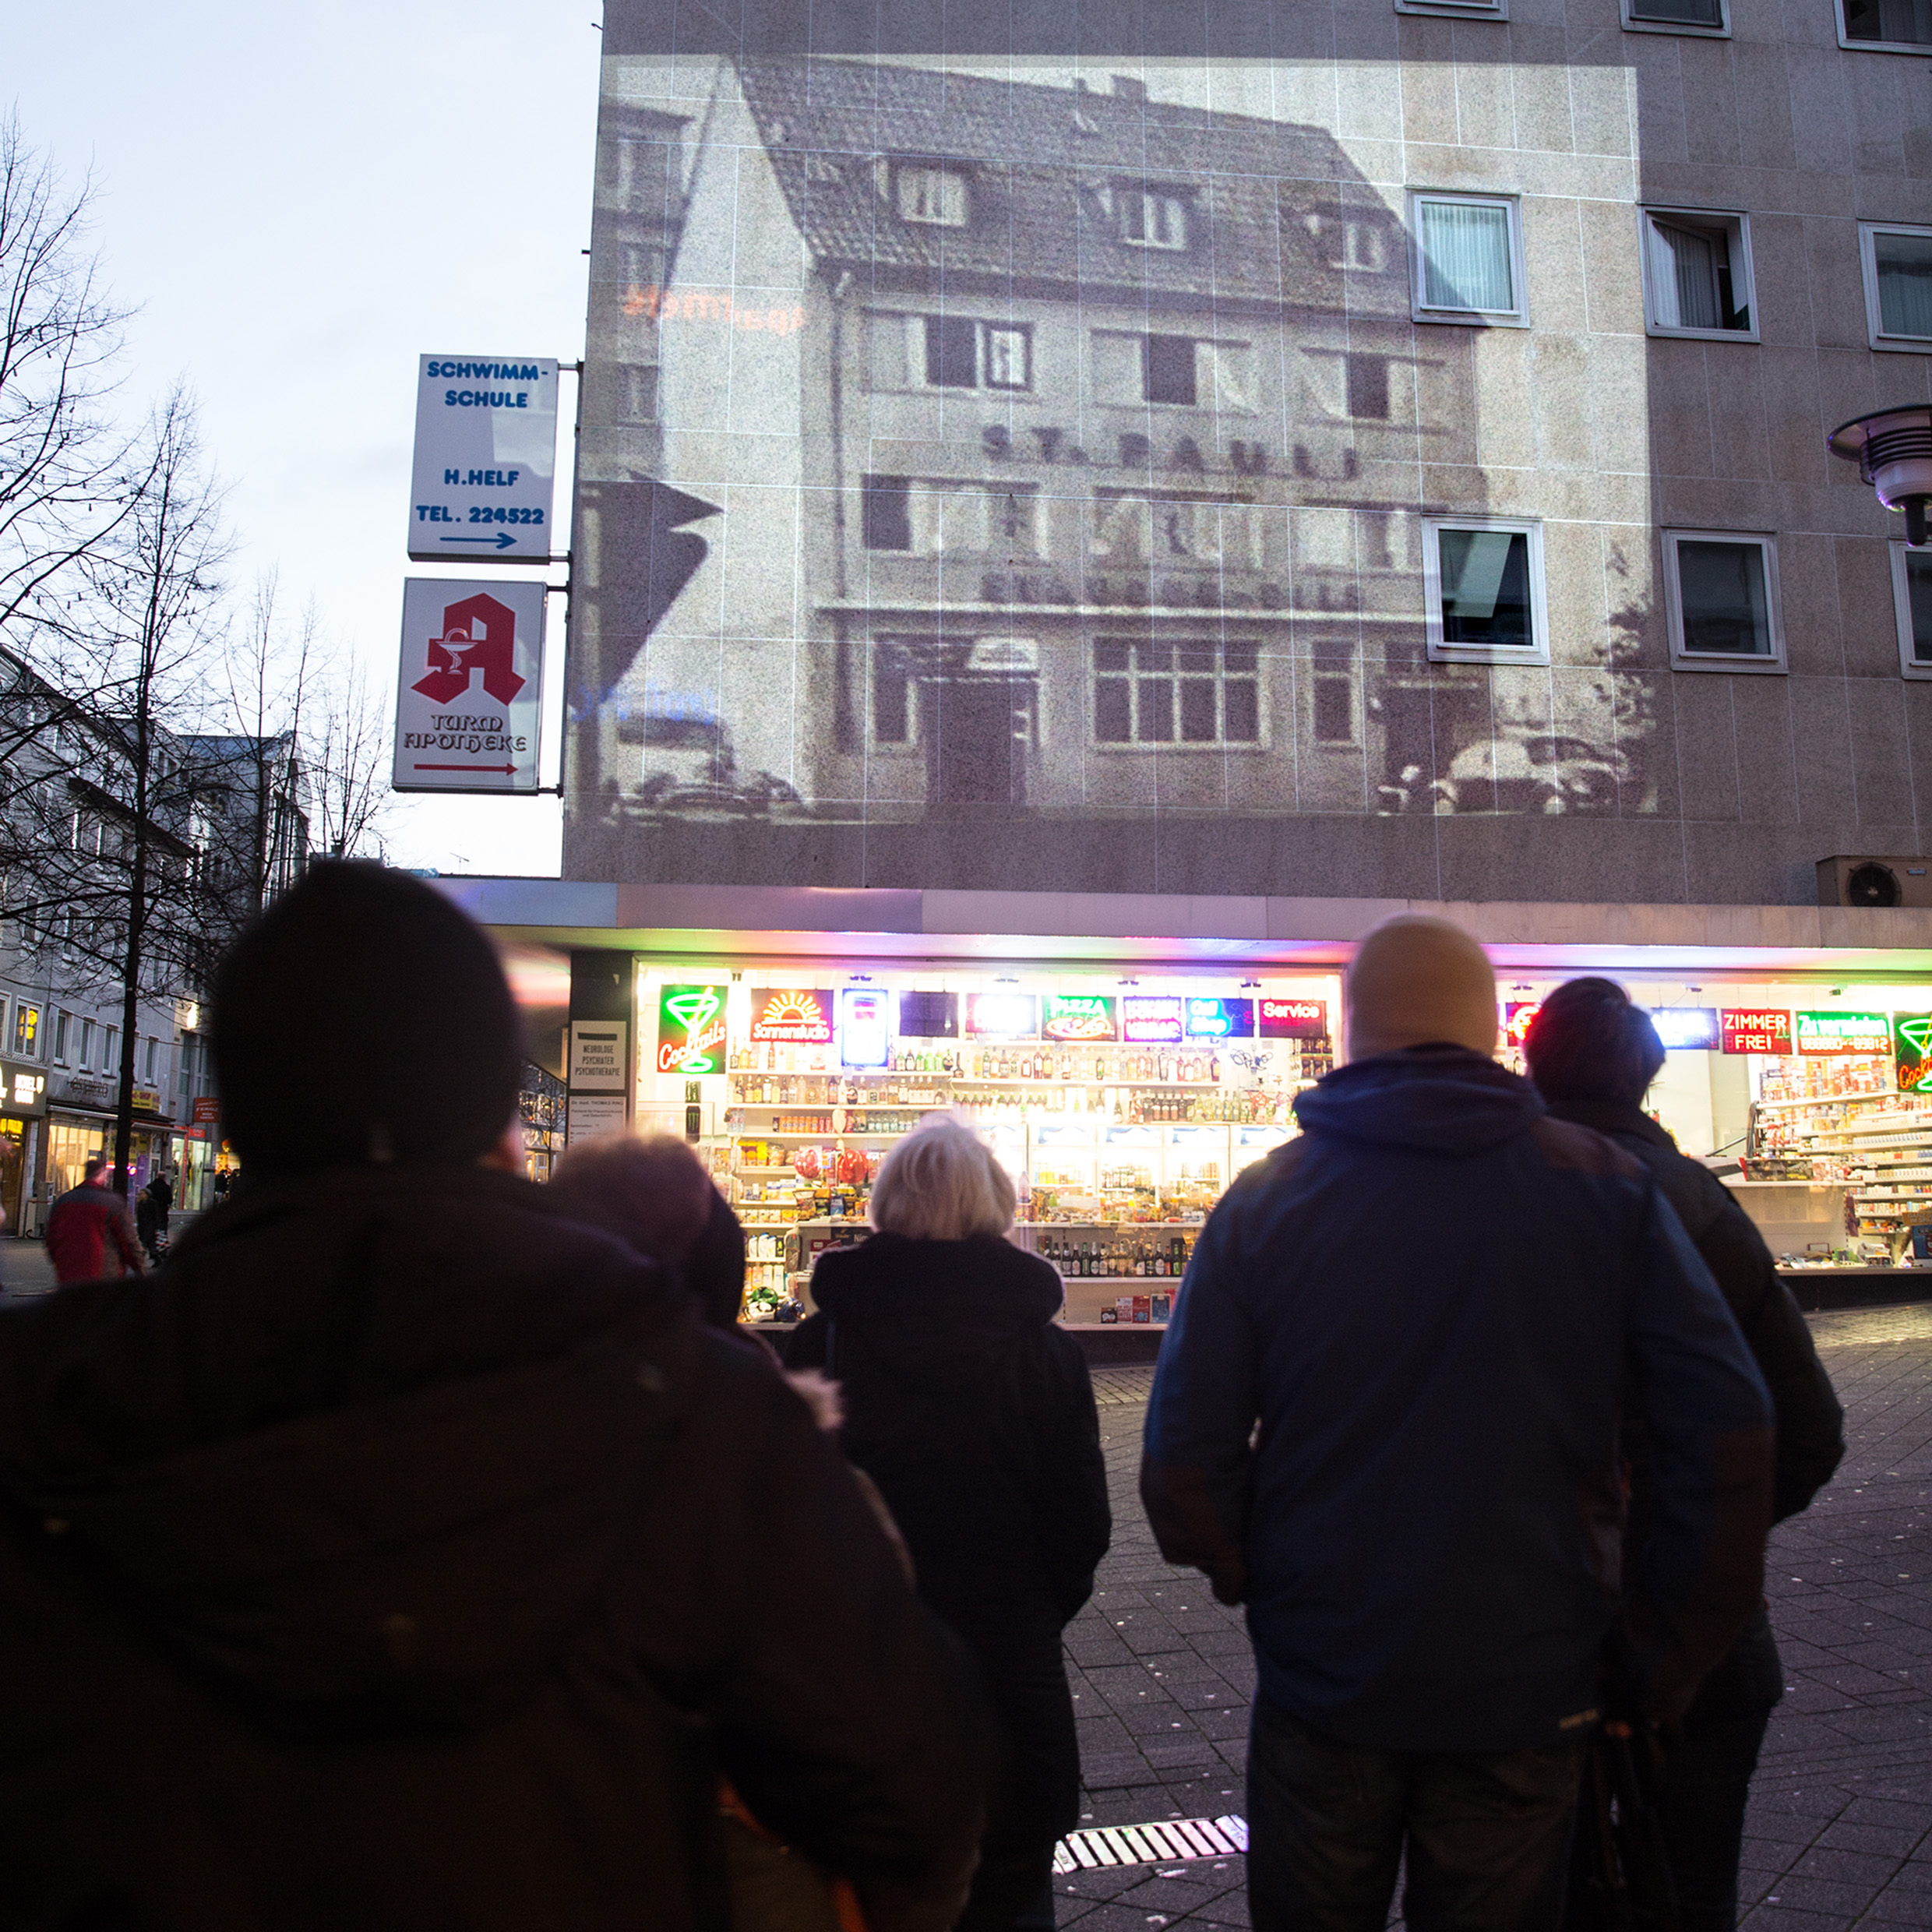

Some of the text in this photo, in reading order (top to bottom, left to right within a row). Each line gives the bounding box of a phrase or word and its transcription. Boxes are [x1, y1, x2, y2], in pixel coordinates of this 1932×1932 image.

[427, 361, 548, 381] SCHWIMM-
[445, 390, 528, 407] SCHULE
[444, 468, 520, 486] H.HELF
[416, 505, 545, 524] TEL. 224522
[431, 714, 503, 732] TURM
[404, 733, 527, 753] APOTHEKE
[1051, 998, 1107, 1018] PIZZA
[1263, 1001, 1320, 1018] Service
[1723, 1014, 1787, 1030] ZIMMER
[753, 1023, 830, 1040] Sonnenstudio
[583, 1045, 614, 1053] NEUROLOGE
[658, 1020, 726, 1070] Cocktails
[1734, 1035, 1772, 1050] FREI
[582, 1056, 614, 1065] PSYCHIATER
[575, 1066, 621, 1077] PSYCHOTHERAPIE
